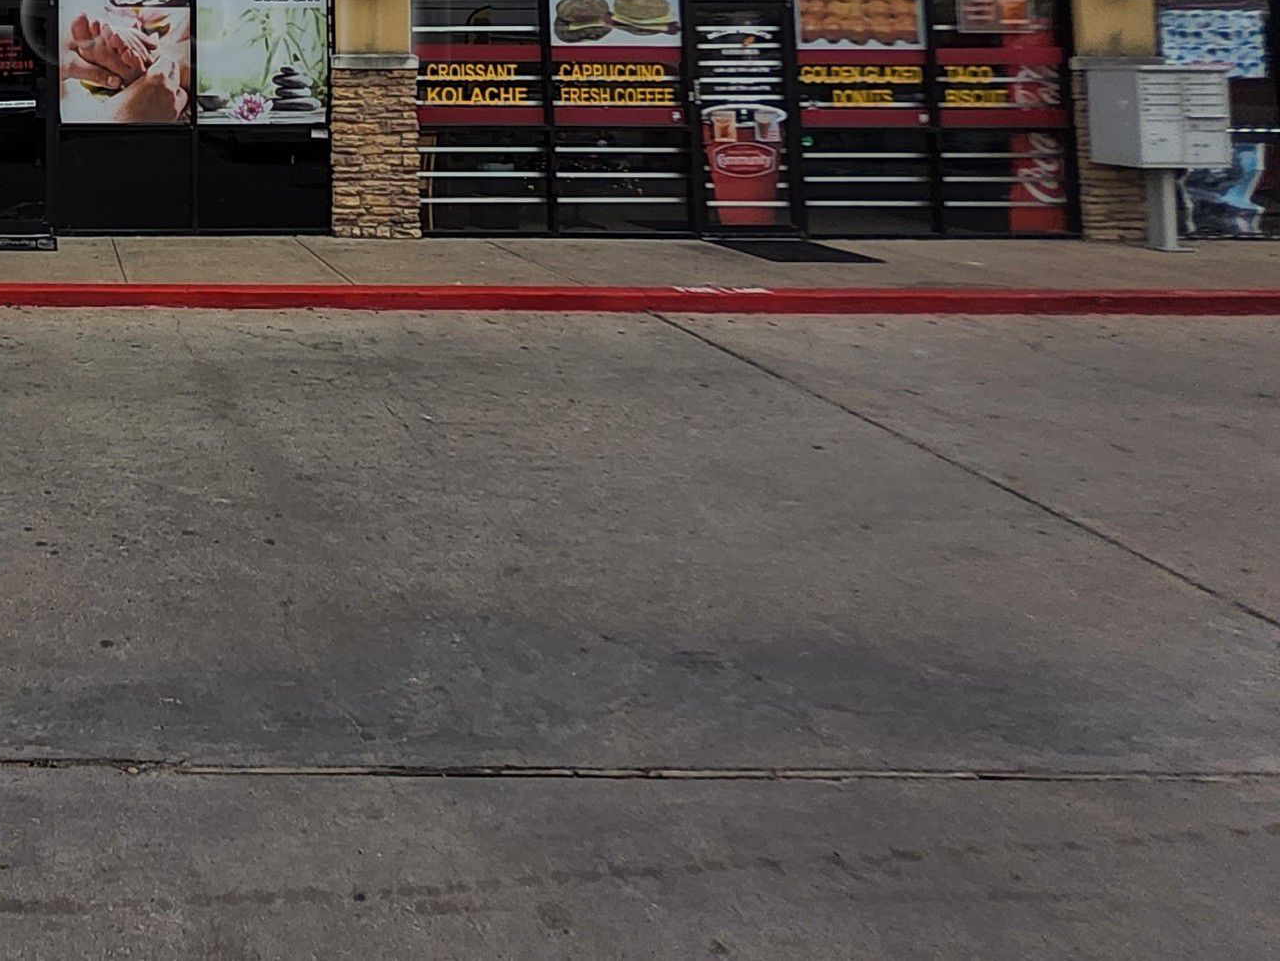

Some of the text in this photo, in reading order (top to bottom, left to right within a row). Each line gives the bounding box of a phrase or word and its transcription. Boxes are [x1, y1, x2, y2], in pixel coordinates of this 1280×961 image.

[426, 64, 518, 81] CROISSANT
[560, 64, 664, 81] CAPPUCCINO
[944, 66, 993, 84] TACO
[426, 87, 528, 106] KOLACHE
[560, 87, 674, 106] FRESH COFFEE
[832, 89, 893, 106] DONUTS
